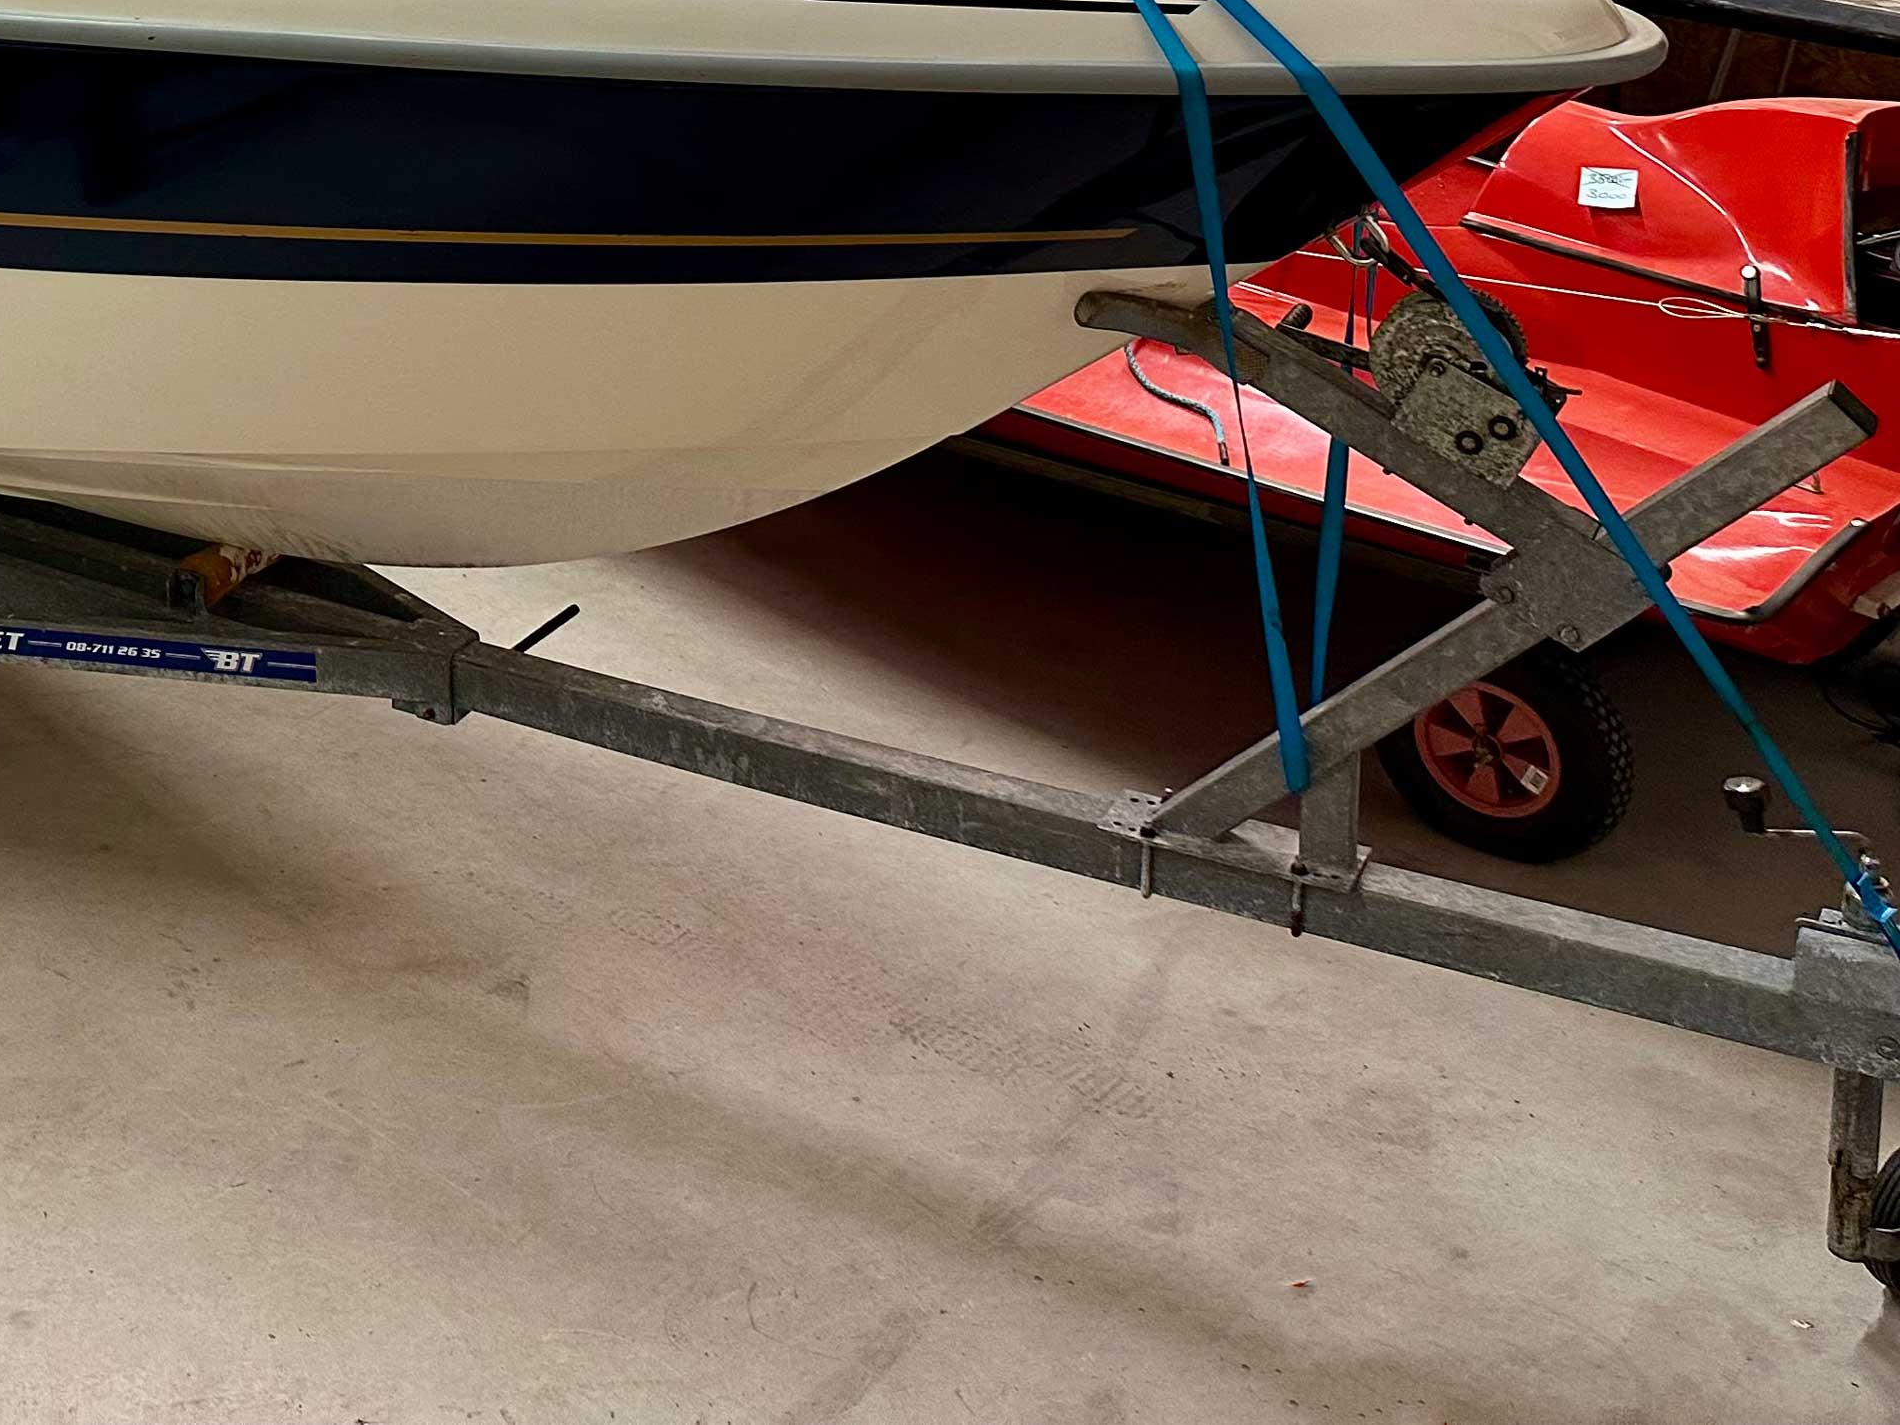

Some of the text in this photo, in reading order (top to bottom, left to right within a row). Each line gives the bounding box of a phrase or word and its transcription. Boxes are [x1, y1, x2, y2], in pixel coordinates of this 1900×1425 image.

[66, 641, 114, 655] 08-711
[117, 646, 139, 657] 26
[141, 648, 162, 659] 35
[206, 649, 263, 673] BT
